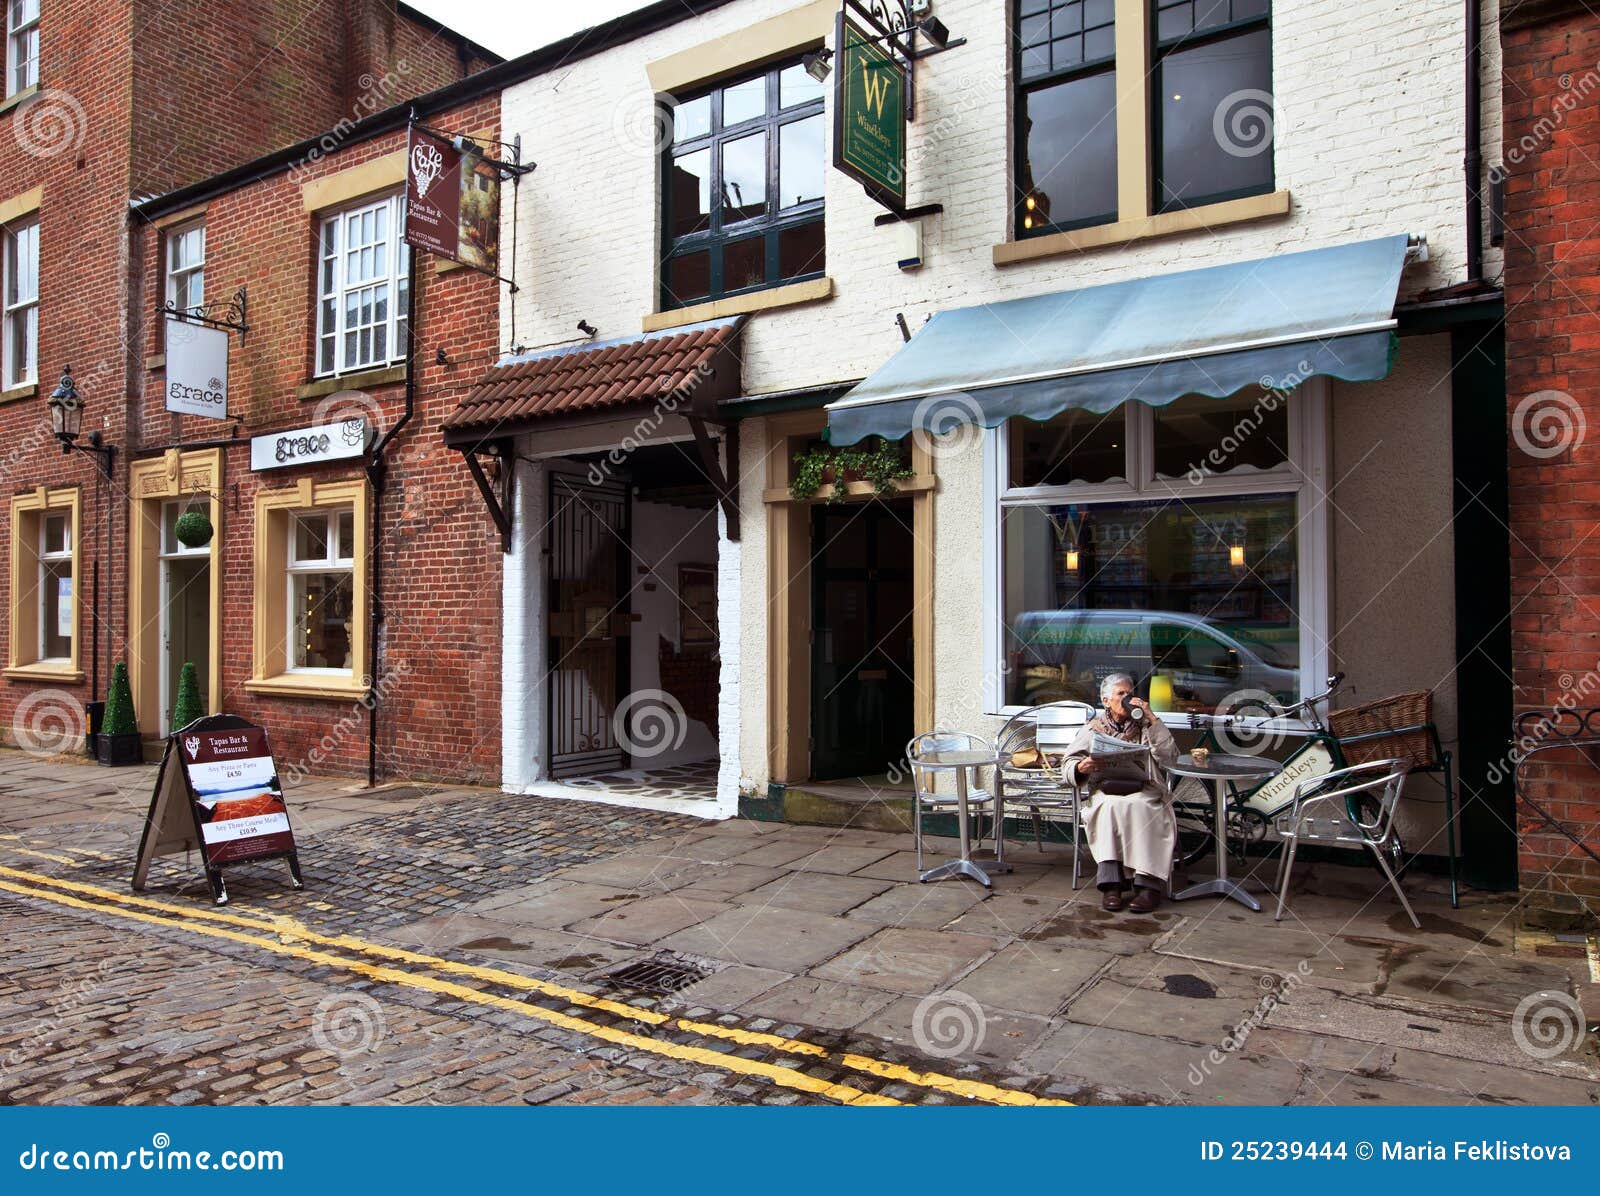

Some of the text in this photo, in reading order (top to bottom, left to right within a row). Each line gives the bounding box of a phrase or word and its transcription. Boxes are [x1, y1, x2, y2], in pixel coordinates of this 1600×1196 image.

[859, 55, 891, 120] W
[410, 199, 441, 218] Tapas Bar &
[410, 208, 438, 226] Restaurant
[170, 382, 223, 404] grace
[275, 433, 330, 462] grace
[209, 737, 228, 747] Tapas
[229, 736, 240, 744] Bar
[241, 735, 248, 743] &
[213, 745, 248, 754] Restaurant
[1256, 756, 1317, 801] Winckleys
